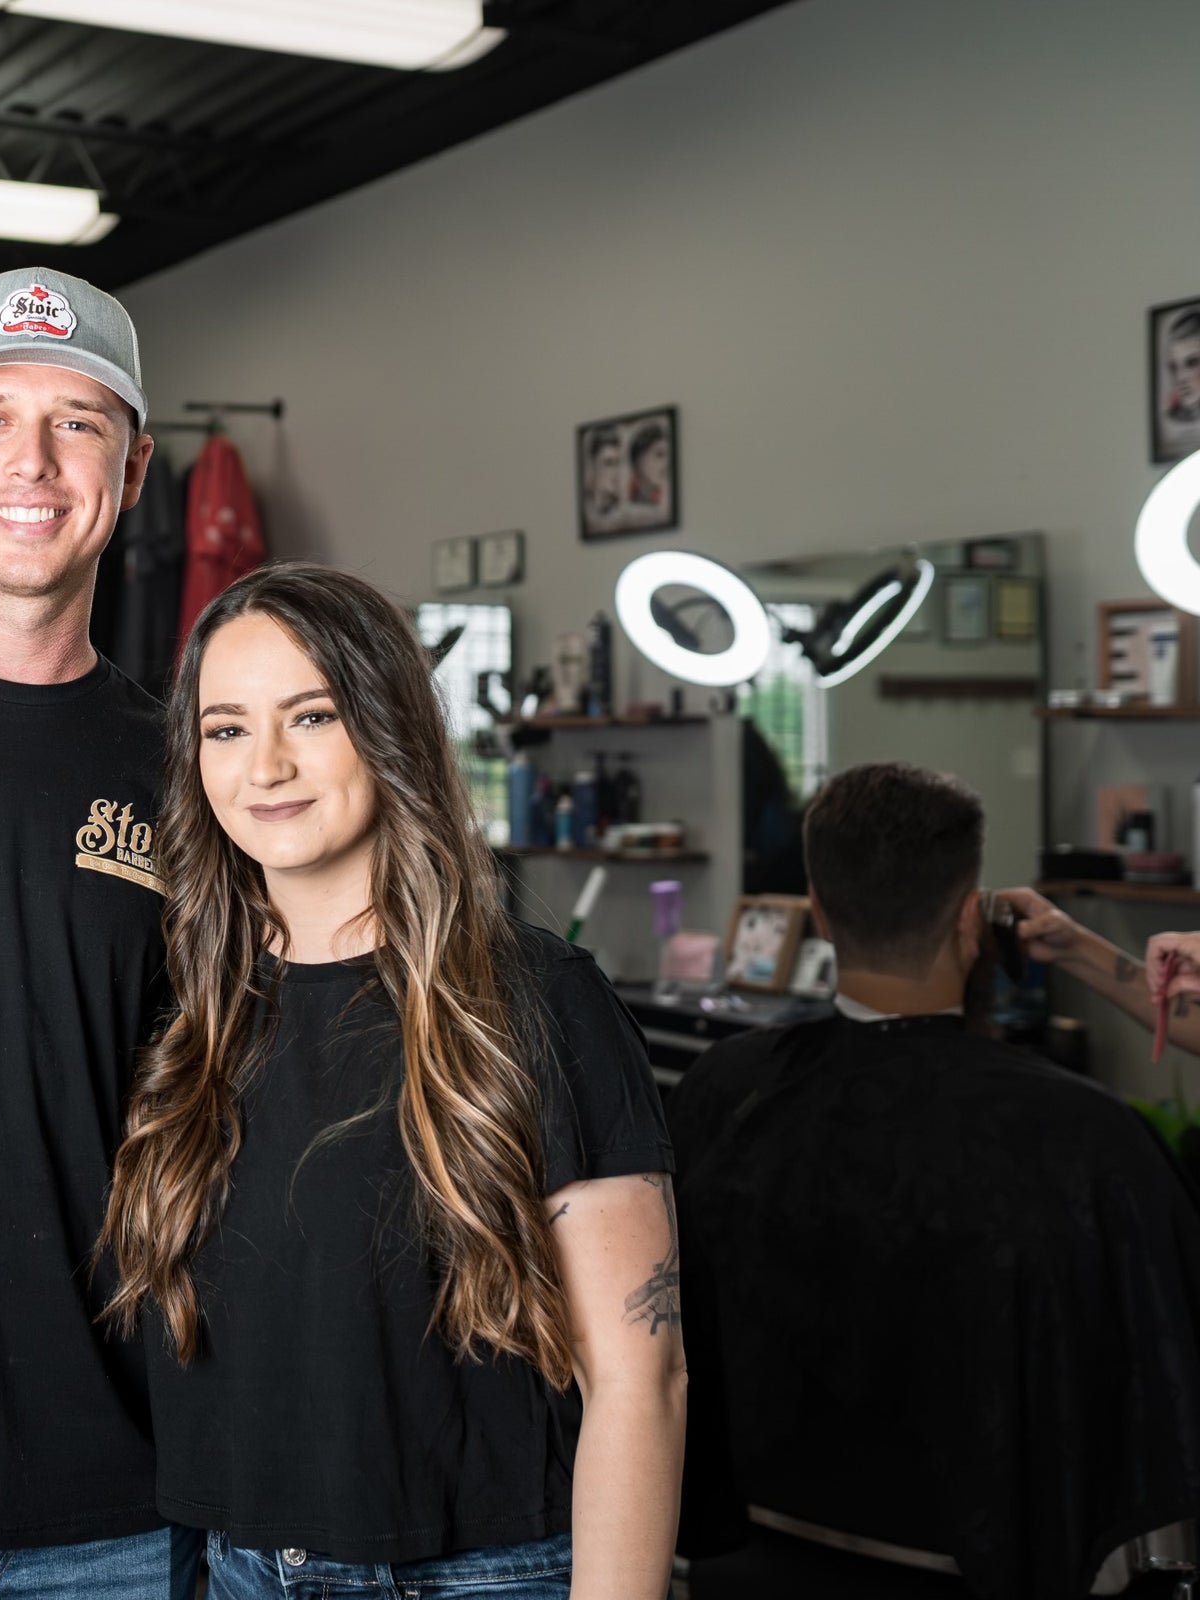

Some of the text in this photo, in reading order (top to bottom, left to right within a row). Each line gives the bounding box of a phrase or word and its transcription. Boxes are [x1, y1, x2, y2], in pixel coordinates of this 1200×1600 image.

[13, 297, 59, 318] Stoic
[76, 799, 154, 855] Sto
[116, 848, 155, 872] BARBE
